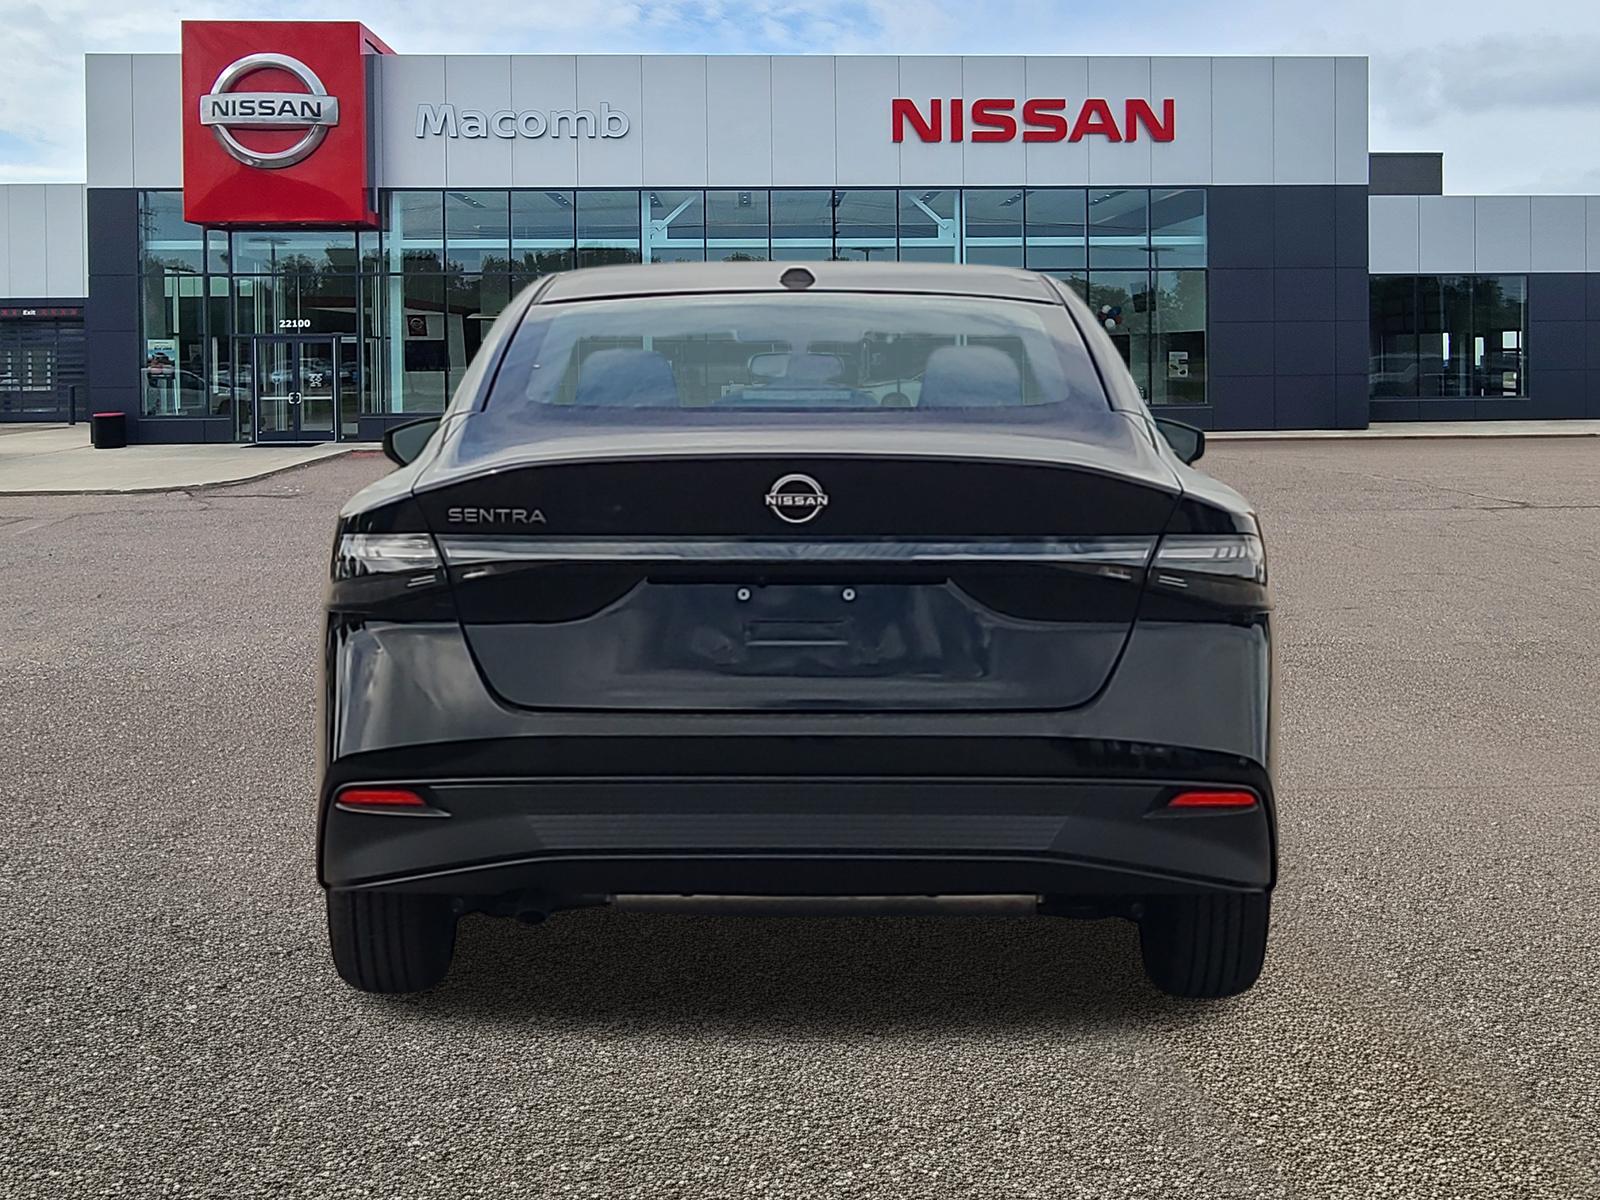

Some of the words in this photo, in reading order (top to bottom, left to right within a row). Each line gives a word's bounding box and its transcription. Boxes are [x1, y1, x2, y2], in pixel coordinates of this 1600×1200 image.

[212, 100, 322, 118] NISSAN
[415, 102, 630, 139] Macomb
[892, 98, 1176, 143] NISSAN
[279, 319, 311, 328] 22100
[765, 494, 829, 506] NISSAN
[448, 508, 547, 524] SENTRA
